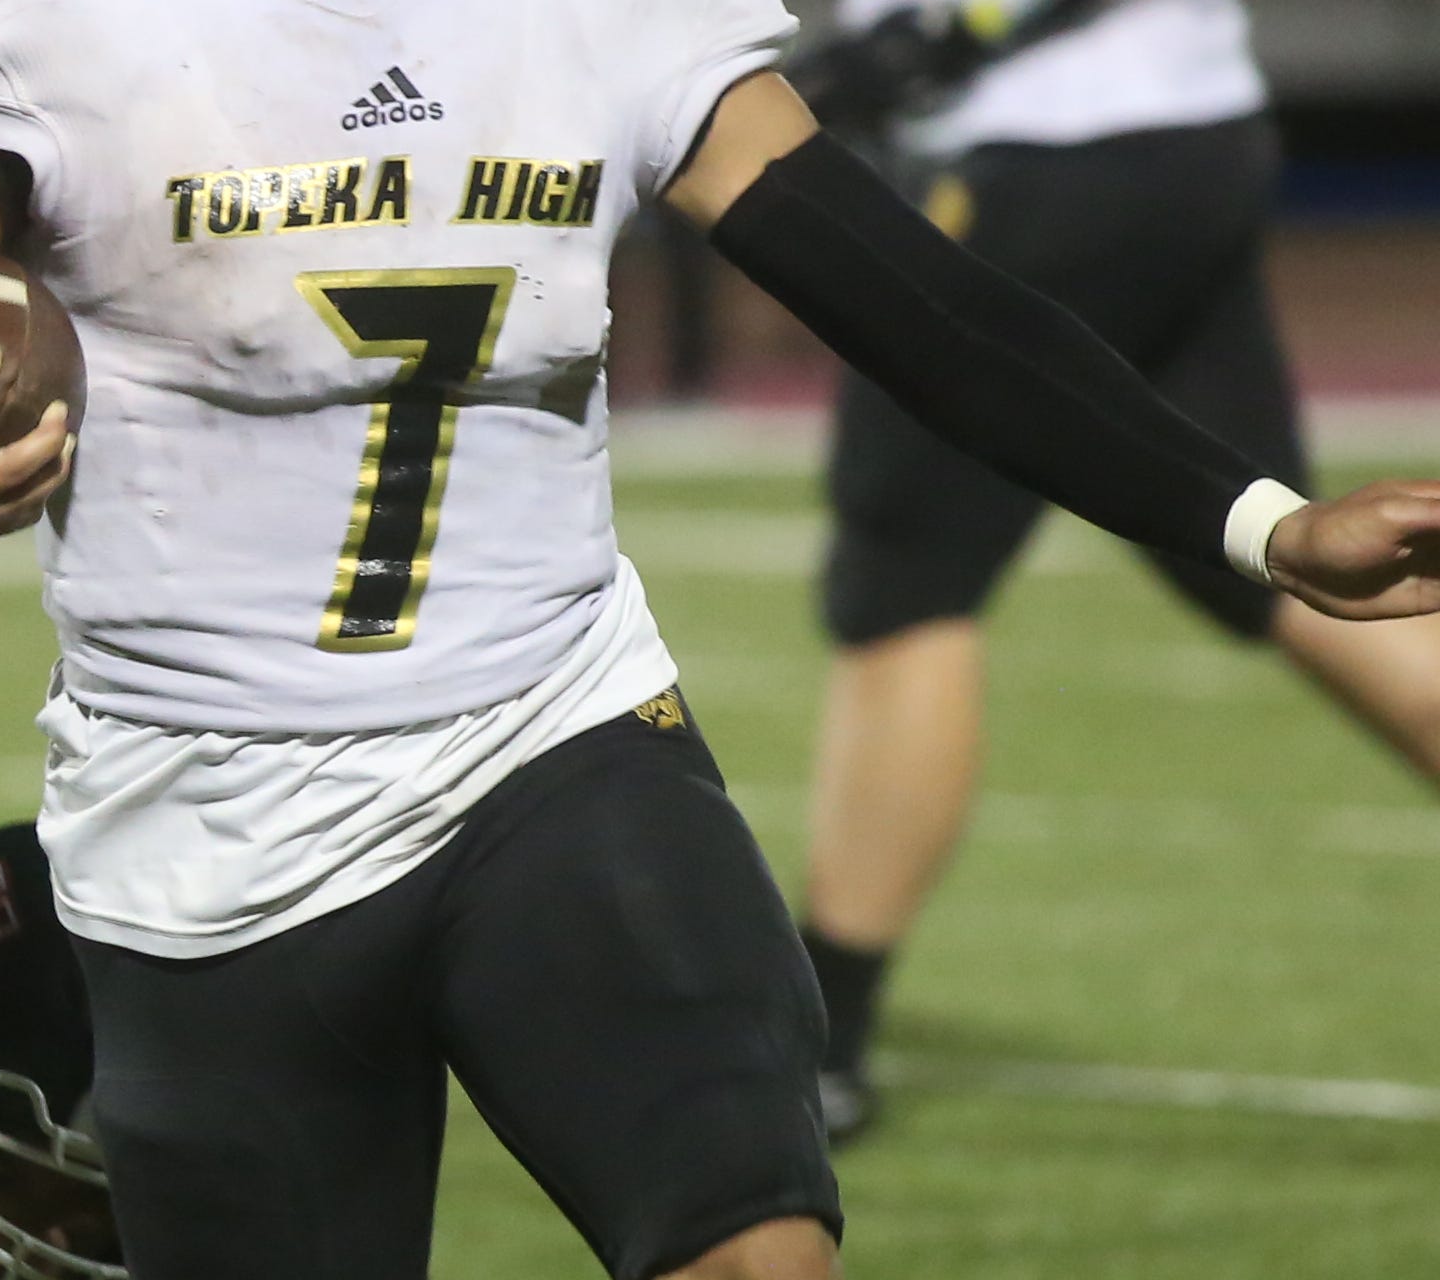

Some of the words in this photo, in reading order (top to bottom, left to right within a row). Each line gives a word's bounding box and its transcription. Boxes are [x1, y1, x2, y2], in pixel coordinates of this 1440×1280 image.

[341, 100, 443, 131] adidas
[165, 154, 413, 243] TOPEKA
[447, 156, 607, 228] HIGH
[293, 266, 517, 654] 7
